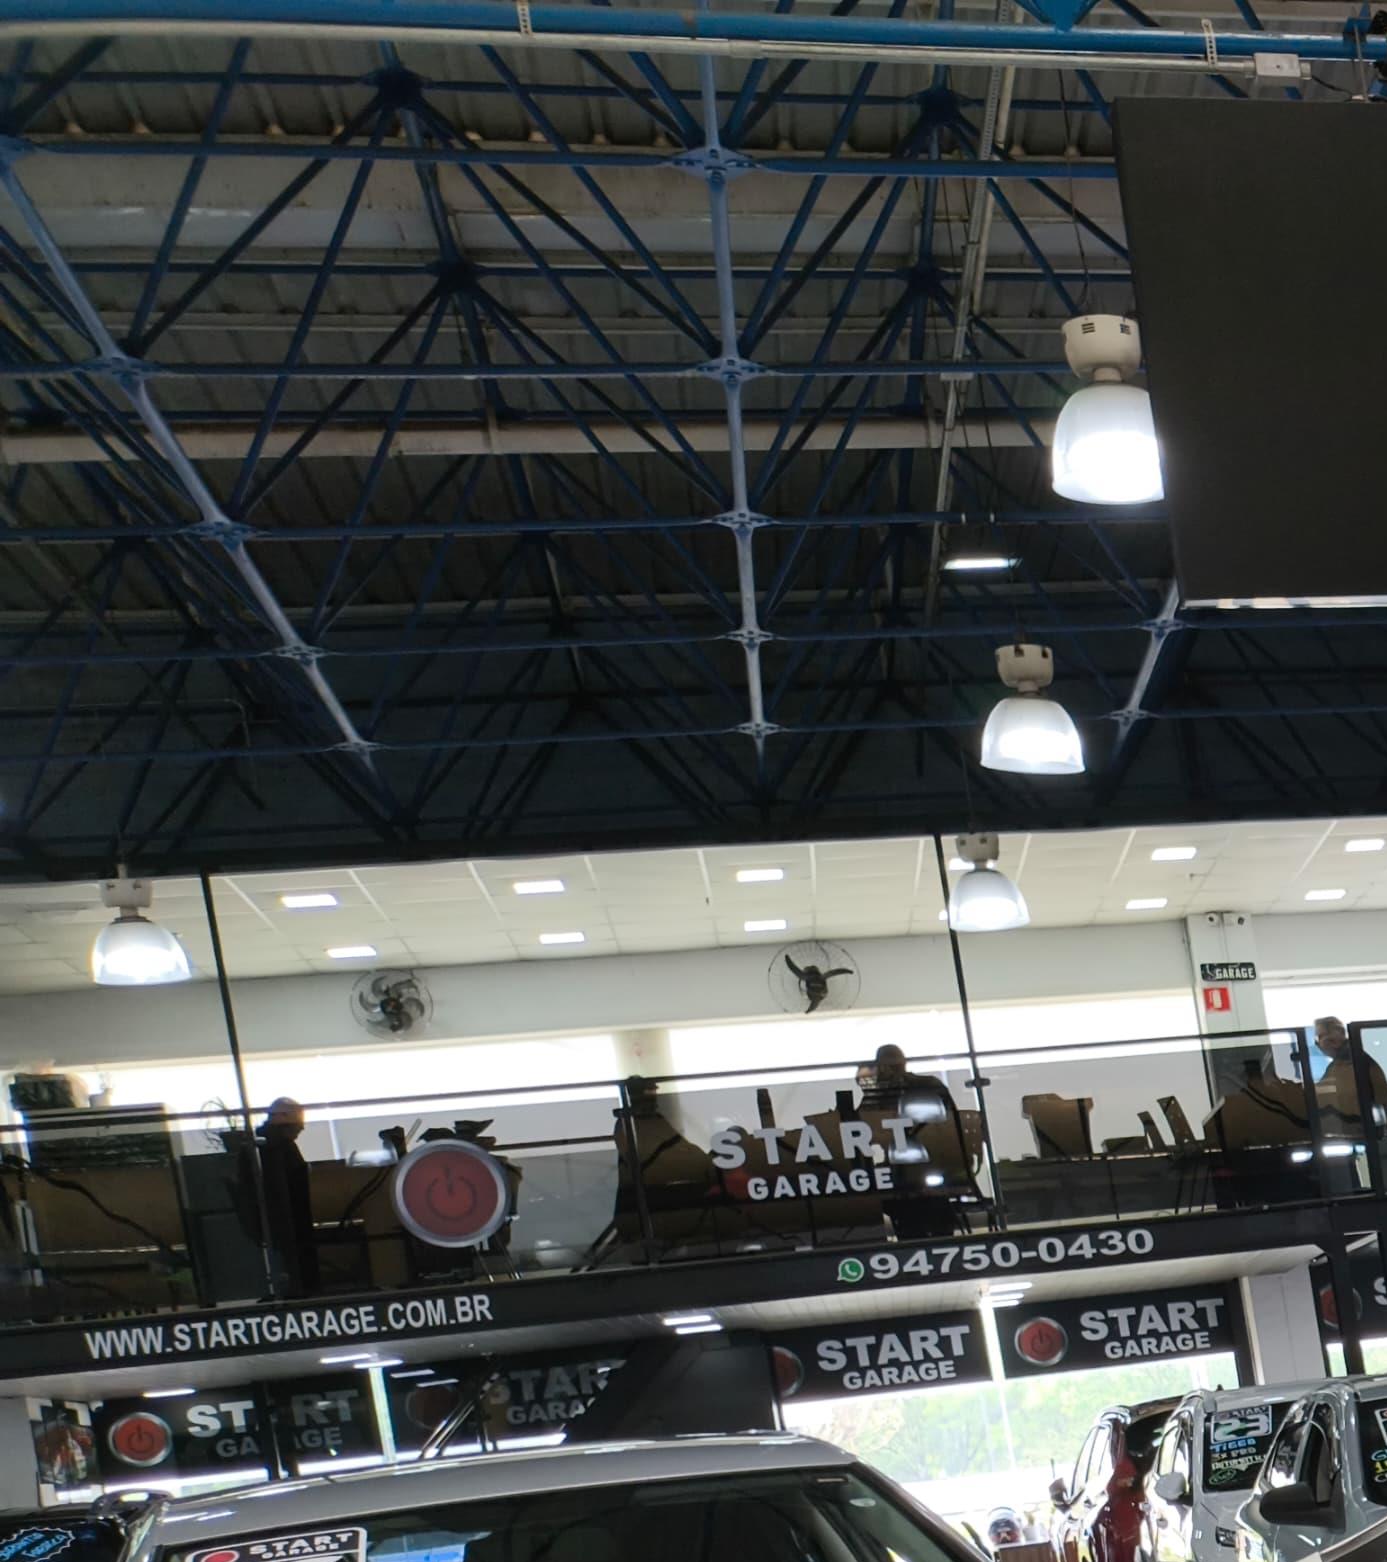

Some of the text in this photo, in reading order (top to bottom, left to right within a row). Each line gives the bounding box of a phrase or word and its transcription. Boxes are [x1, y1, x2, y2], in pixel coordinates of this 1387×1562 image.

[1215, 967, 1255, 980] GARAGE
[710, 1118, 914, 1170] START
[746, 1166, 895, 1201] GARAGE
[868, 1228, 1155, 1280] 94750-0430
[83, 1293, 494, 1360] WWW.STARTGARAGE.COM.BR
[1079, 1297, 1226, 1342] START
[816, 1325, 971, 1372] START
[1103, 1330, 1212, 1360] GARAGE
[842, 1359, 957, 1391] GARAGE
[1214, 1413, 1269, 1442] 23
[249, 1532, 354, 1556] START
[261, 1543, 340, 1560] GARAGE
